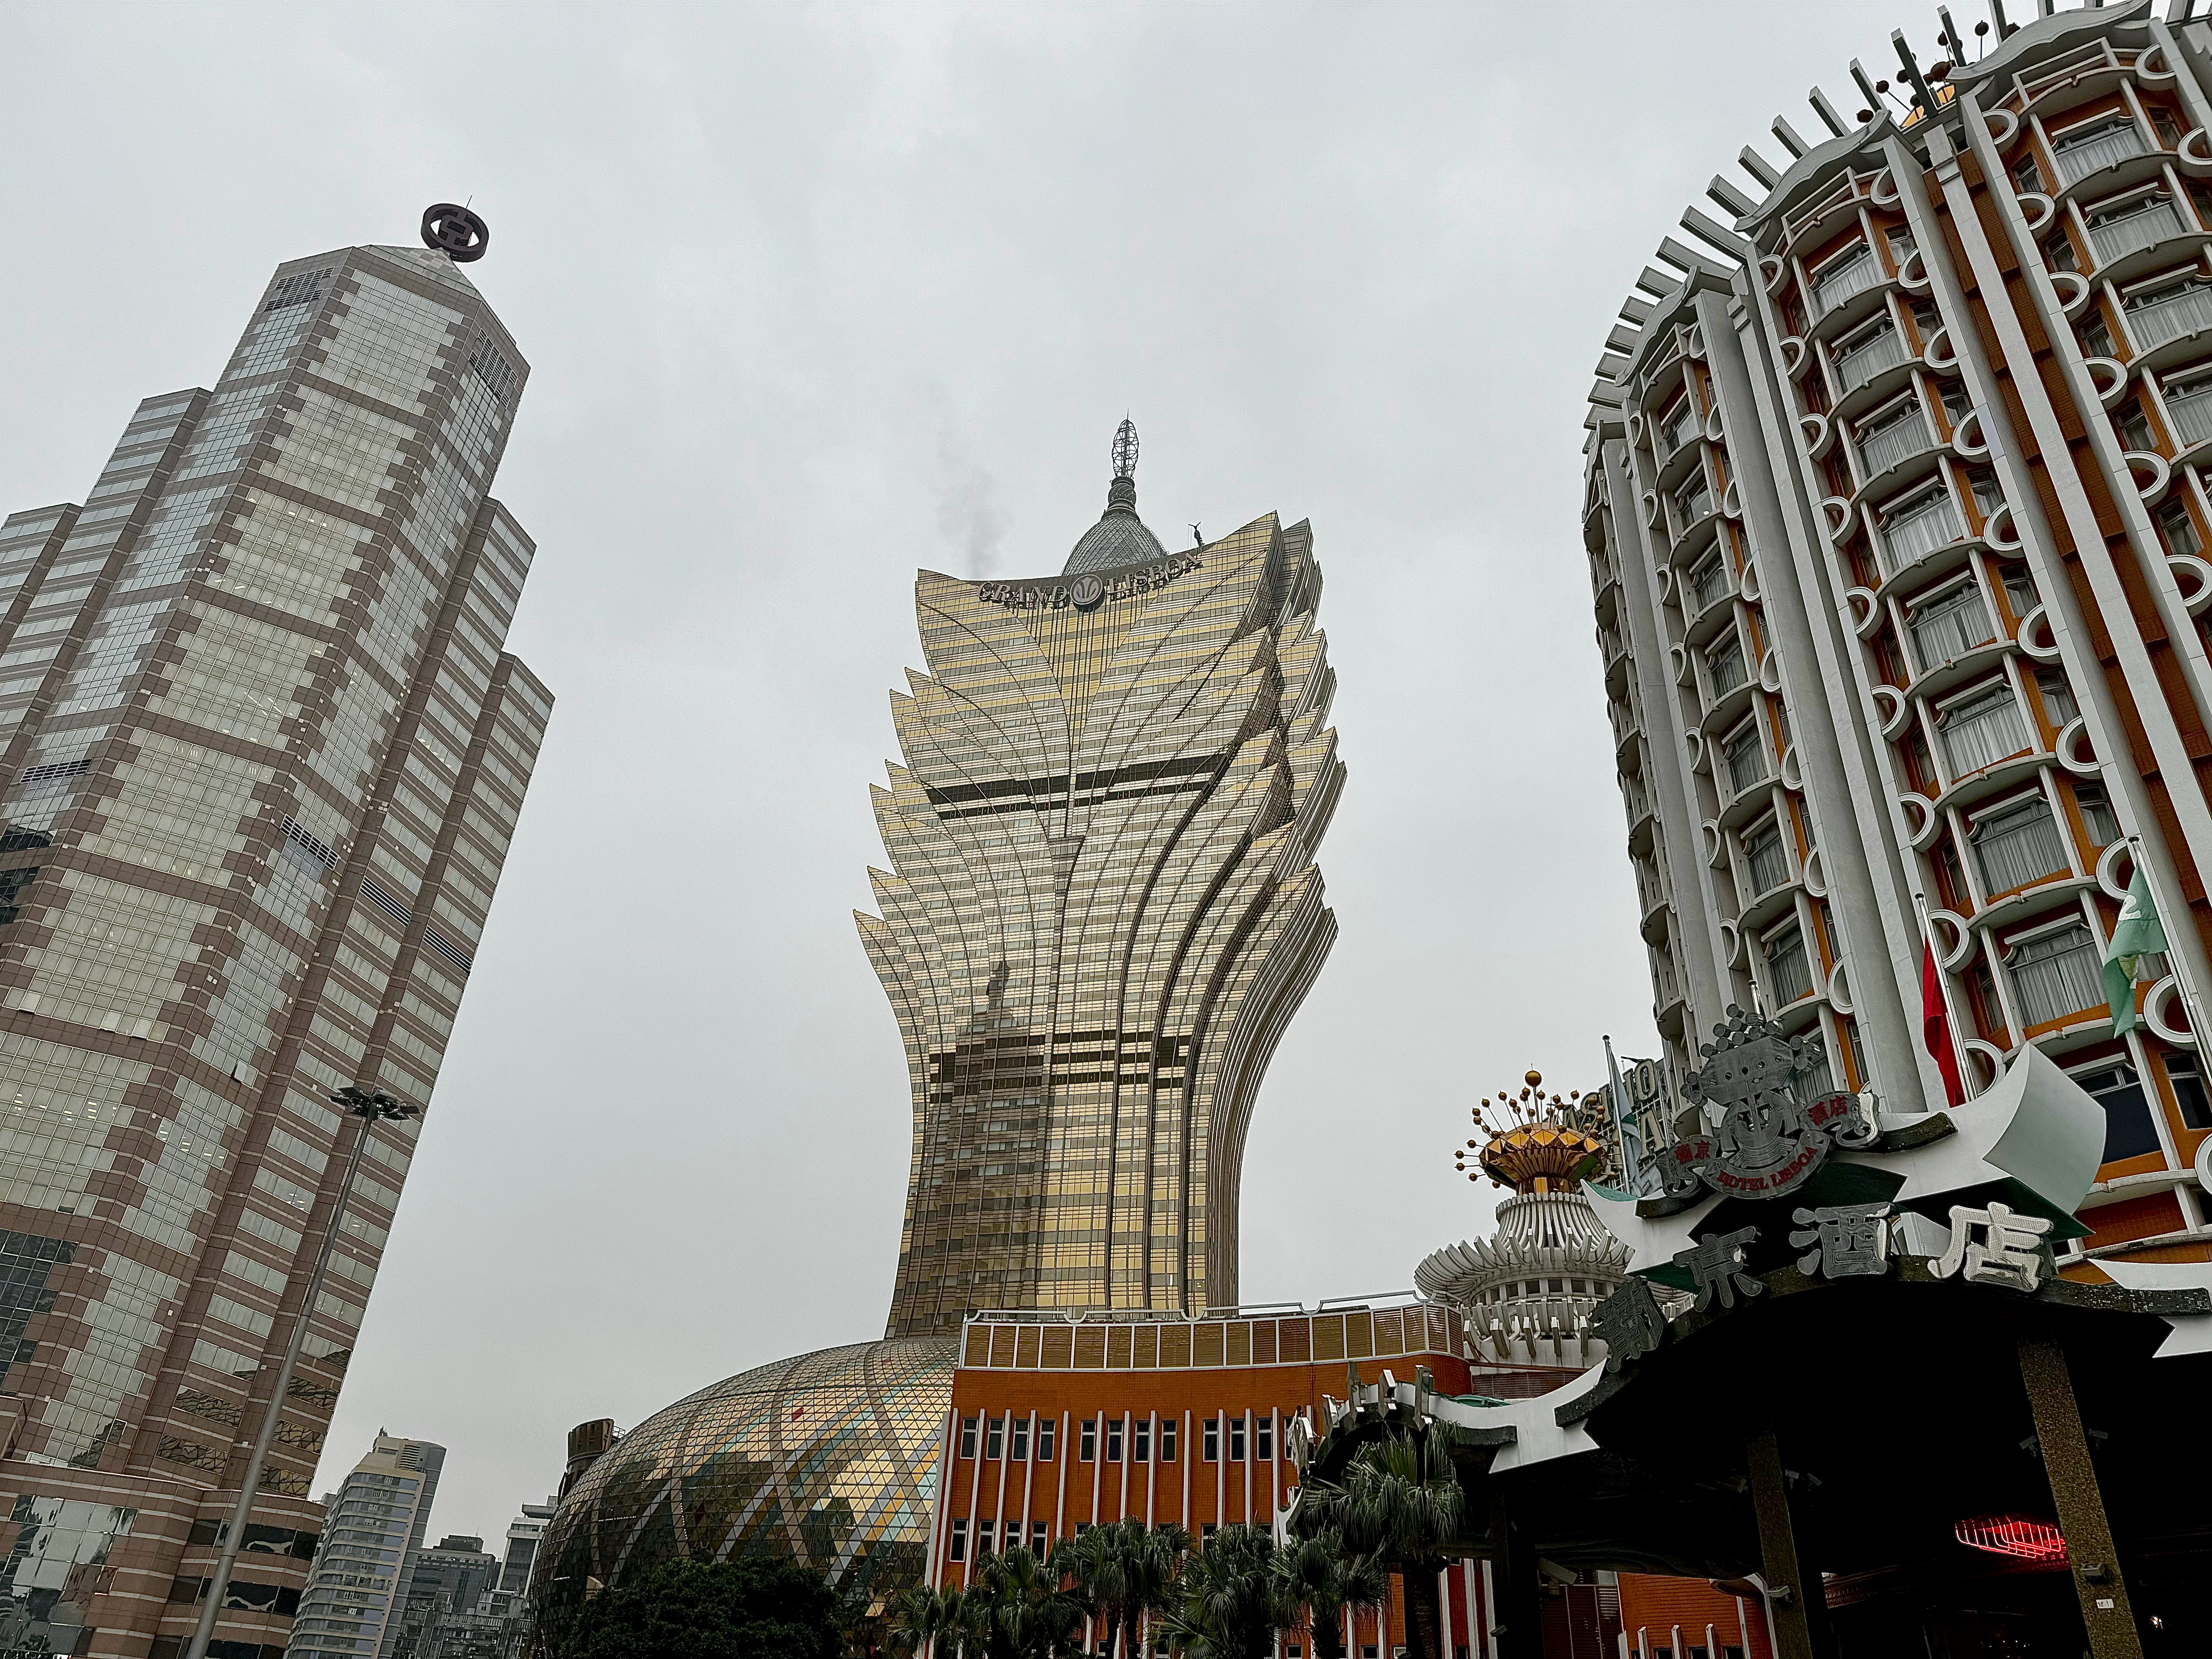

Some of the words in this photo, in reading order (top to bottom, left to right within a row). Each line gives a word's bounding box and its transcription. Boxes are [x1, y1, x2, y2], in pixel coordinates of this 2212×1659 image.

[977, 582, 1068, 608] GRAND
[1107, 552, 1202, 596] LISBOA
[1807, 1095, 1848, 1126] 酒店
[1674, 1140, 1712, 1165] 葡京
[1717, 1171, 1769, 1190] HOTEL
[1769, 1146, 1818, 1187] LISBOA
[1589, 1202, 2051, 1372] 葡京酒店
